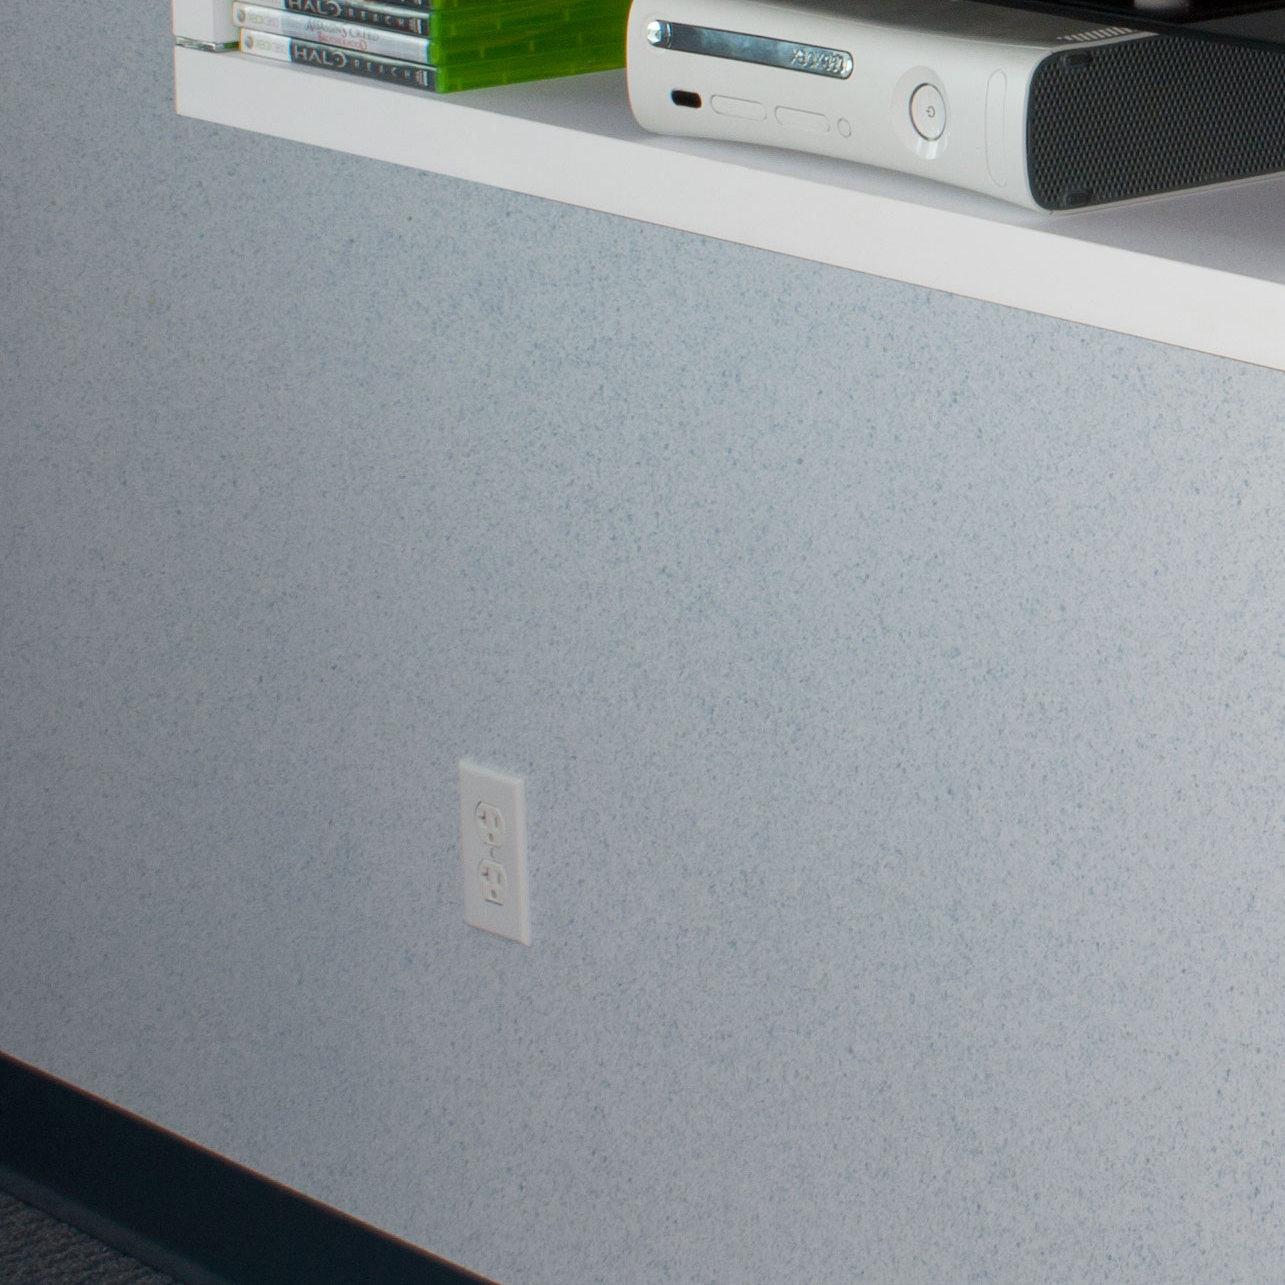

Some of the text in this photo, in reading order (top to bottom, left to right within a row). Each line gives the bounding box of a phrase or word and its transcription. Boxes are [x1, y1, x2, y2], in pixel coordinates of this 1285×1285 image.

[346, 8, 405, 27] REACH
[294, 45, 411, 79] HALO REACH
